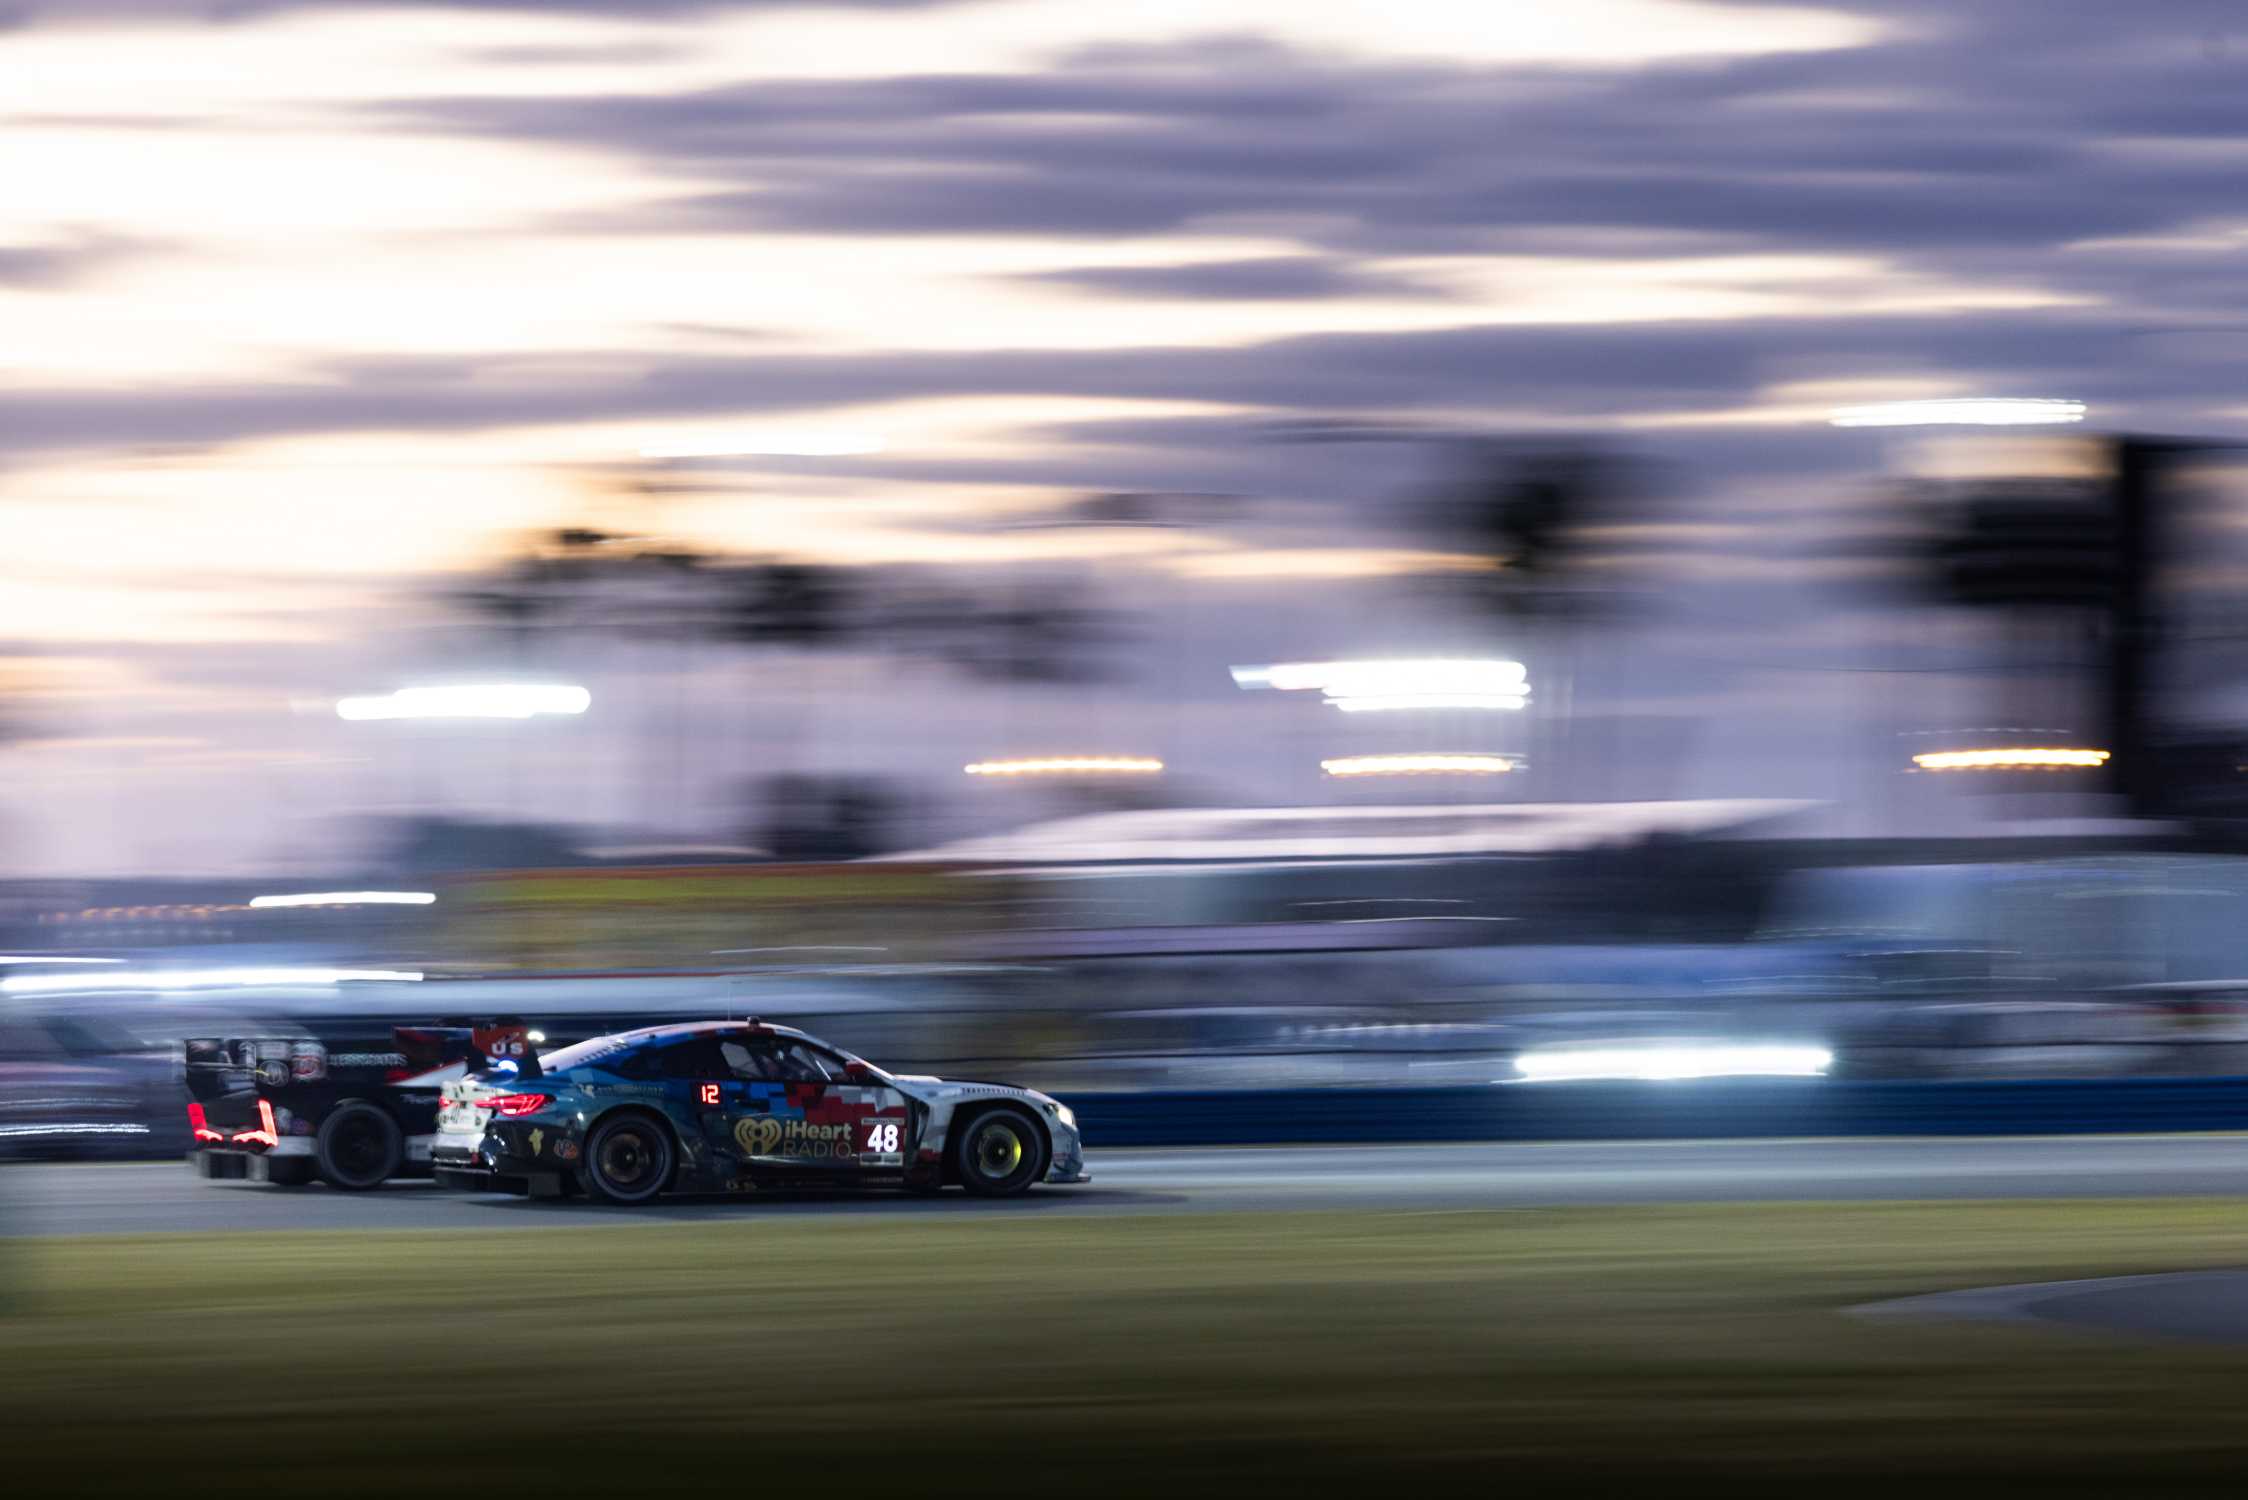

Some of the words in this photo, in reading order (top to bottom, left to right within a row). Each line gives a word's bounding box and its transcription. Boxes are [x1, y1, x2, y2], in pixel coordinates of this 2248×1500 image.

[701, 1084, 720, 1105] 12
[786, 1120, 852, 1140] iHeart
[867, 1124, 899, 1153] 48
[784, 1141, 852, 1159] RADIO
